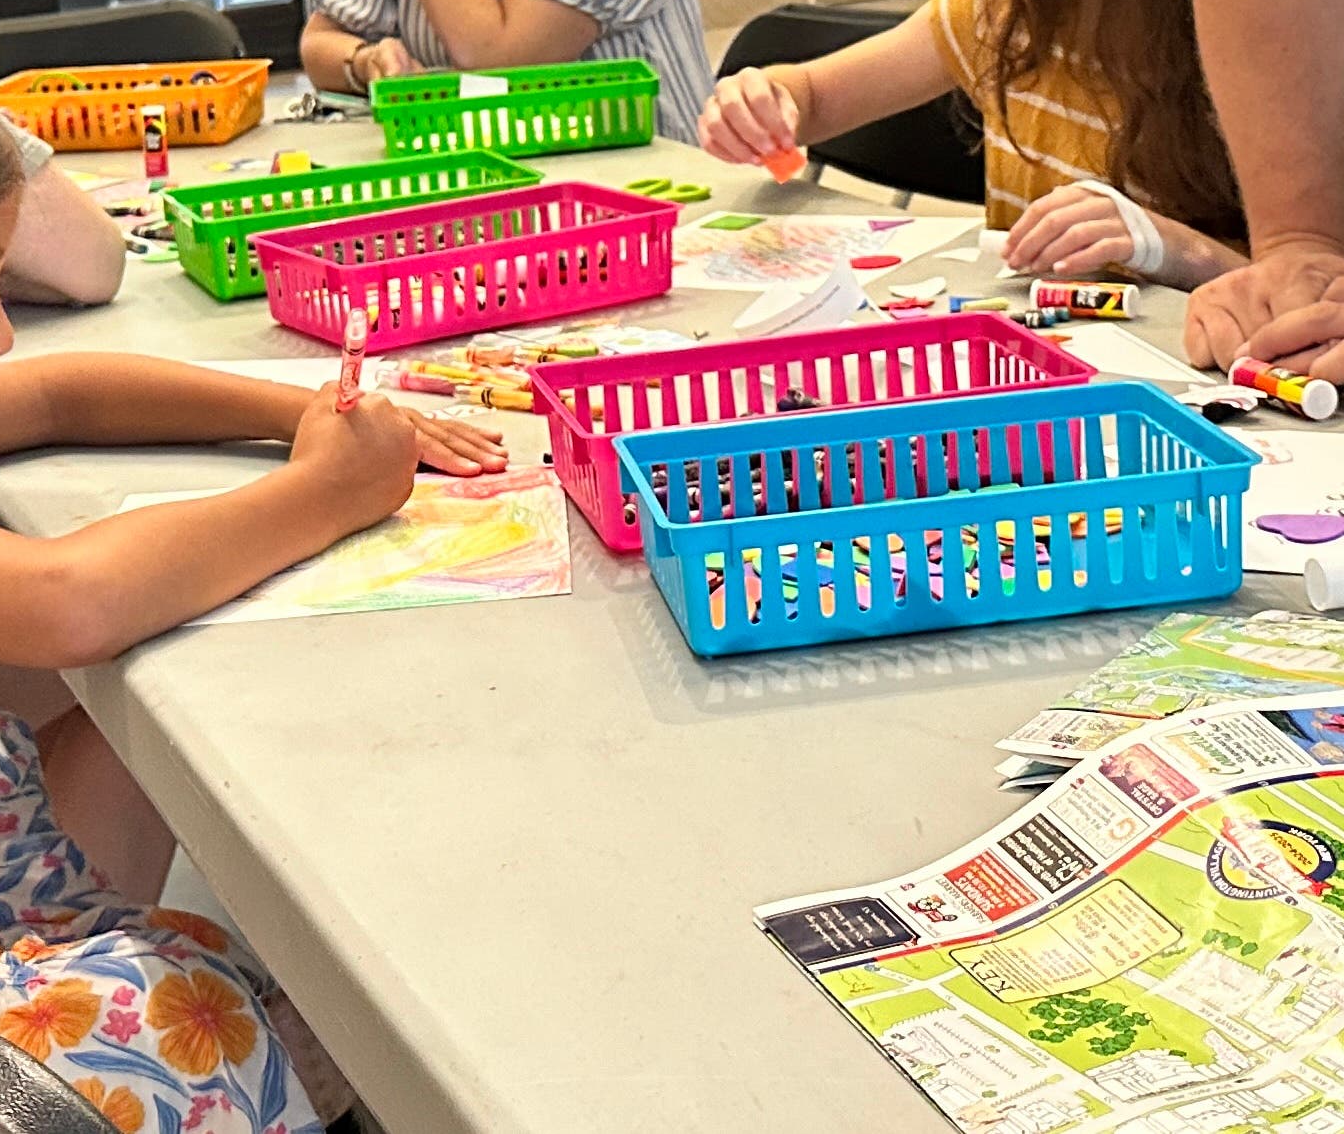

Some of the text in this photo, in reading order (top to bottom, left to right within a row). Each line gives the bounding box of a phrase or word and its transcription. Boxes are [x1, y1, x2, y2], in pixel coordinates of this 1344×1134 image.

[1128, 786, 1164, 815] CRYSTAL
[1136, 781, 1159, 800] SAGE
[1287, 827, 1315, 846] YORK
[1019, 853, 1045, 875] Shore
[1209, 842, 1225, 880] VILLAGE
[1038, 870, 1062, 890] North
[1215, 877, 1281, 898] HUNTINGTON
[952, 876, 997, 912] SUNDAYS
[962, 959, 1015, 994] KEY
